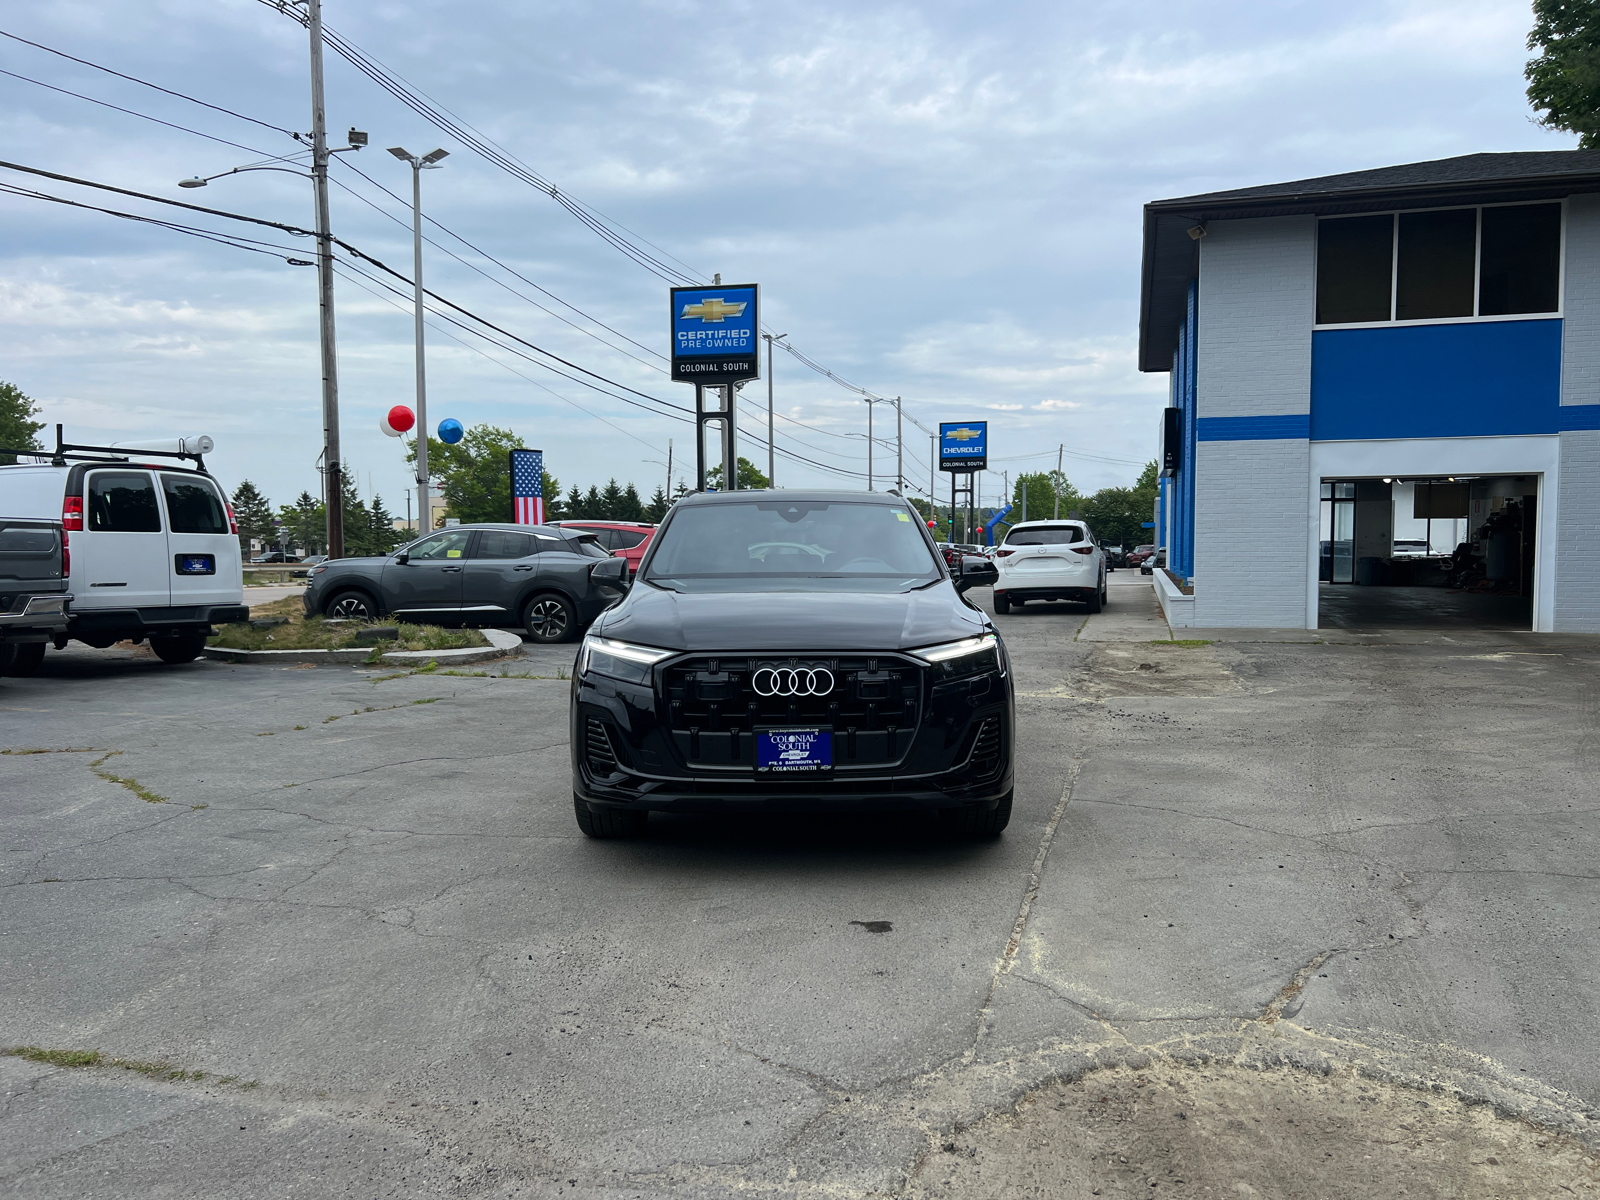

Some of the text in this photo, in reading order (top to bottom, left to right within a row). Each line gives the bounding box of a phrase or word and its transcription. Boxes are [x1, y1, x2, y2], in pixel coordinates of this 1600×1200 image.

[678, 329, 750, 340] CERTIFIED
[681, 338, 747, 348] PRE-OWNED
[680, 362, 749, 372] COLONIAL SOUTH
[771, 735, 817, 743] COLONIAL
